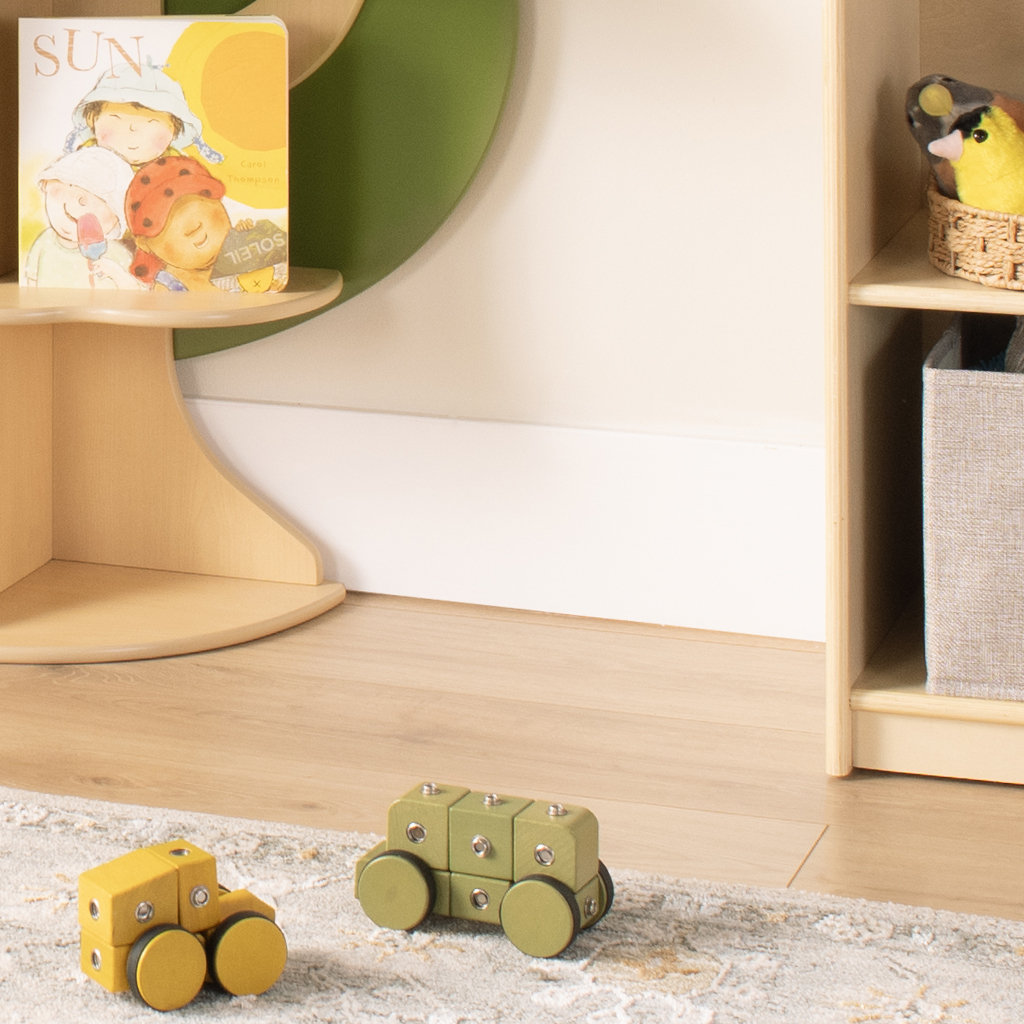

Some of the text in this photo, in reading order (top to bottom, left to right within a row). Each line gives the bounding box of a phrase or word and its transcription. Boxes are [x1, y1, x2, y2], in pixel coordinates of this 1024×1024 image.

[33, 28, 144, 78] SUN
[240, 160, 267, 168] Carol
[226, 175, 280, 186] Thompson
[224, 232, 286, 265] SOLEIL
